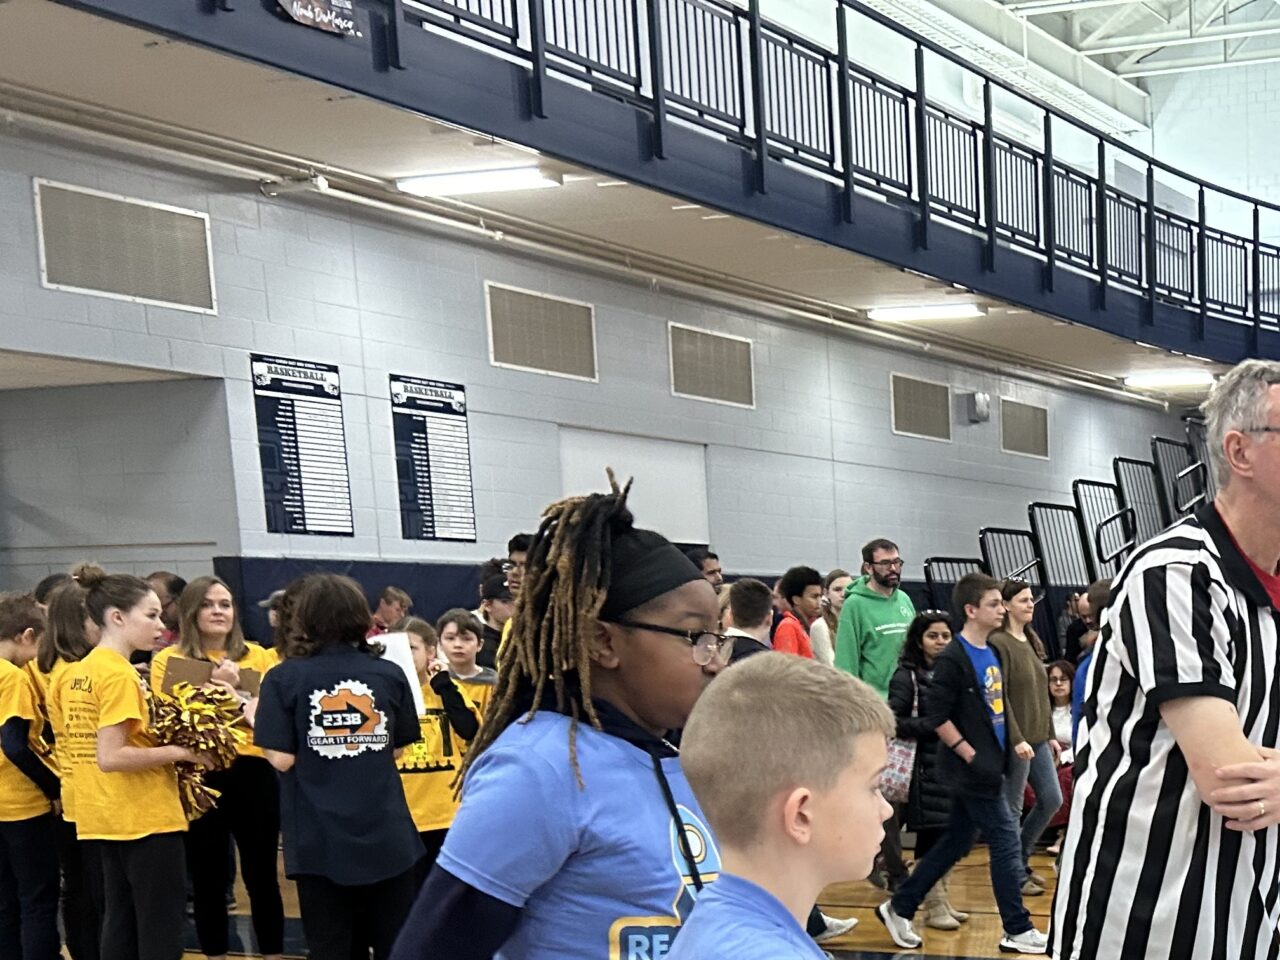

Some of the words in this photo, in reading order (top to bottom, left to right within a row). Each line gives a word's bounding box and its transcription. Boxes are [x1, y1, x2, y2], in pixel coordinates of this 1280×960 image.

[266, 364, 327, 382] BASKETBALL
[403, 384, 455, 400] BASKETBALL
[322, 713, 362, 727] 2338
[310, 736, 335, 745] GEAR
[346, 735, 386, 744] FORWARD
